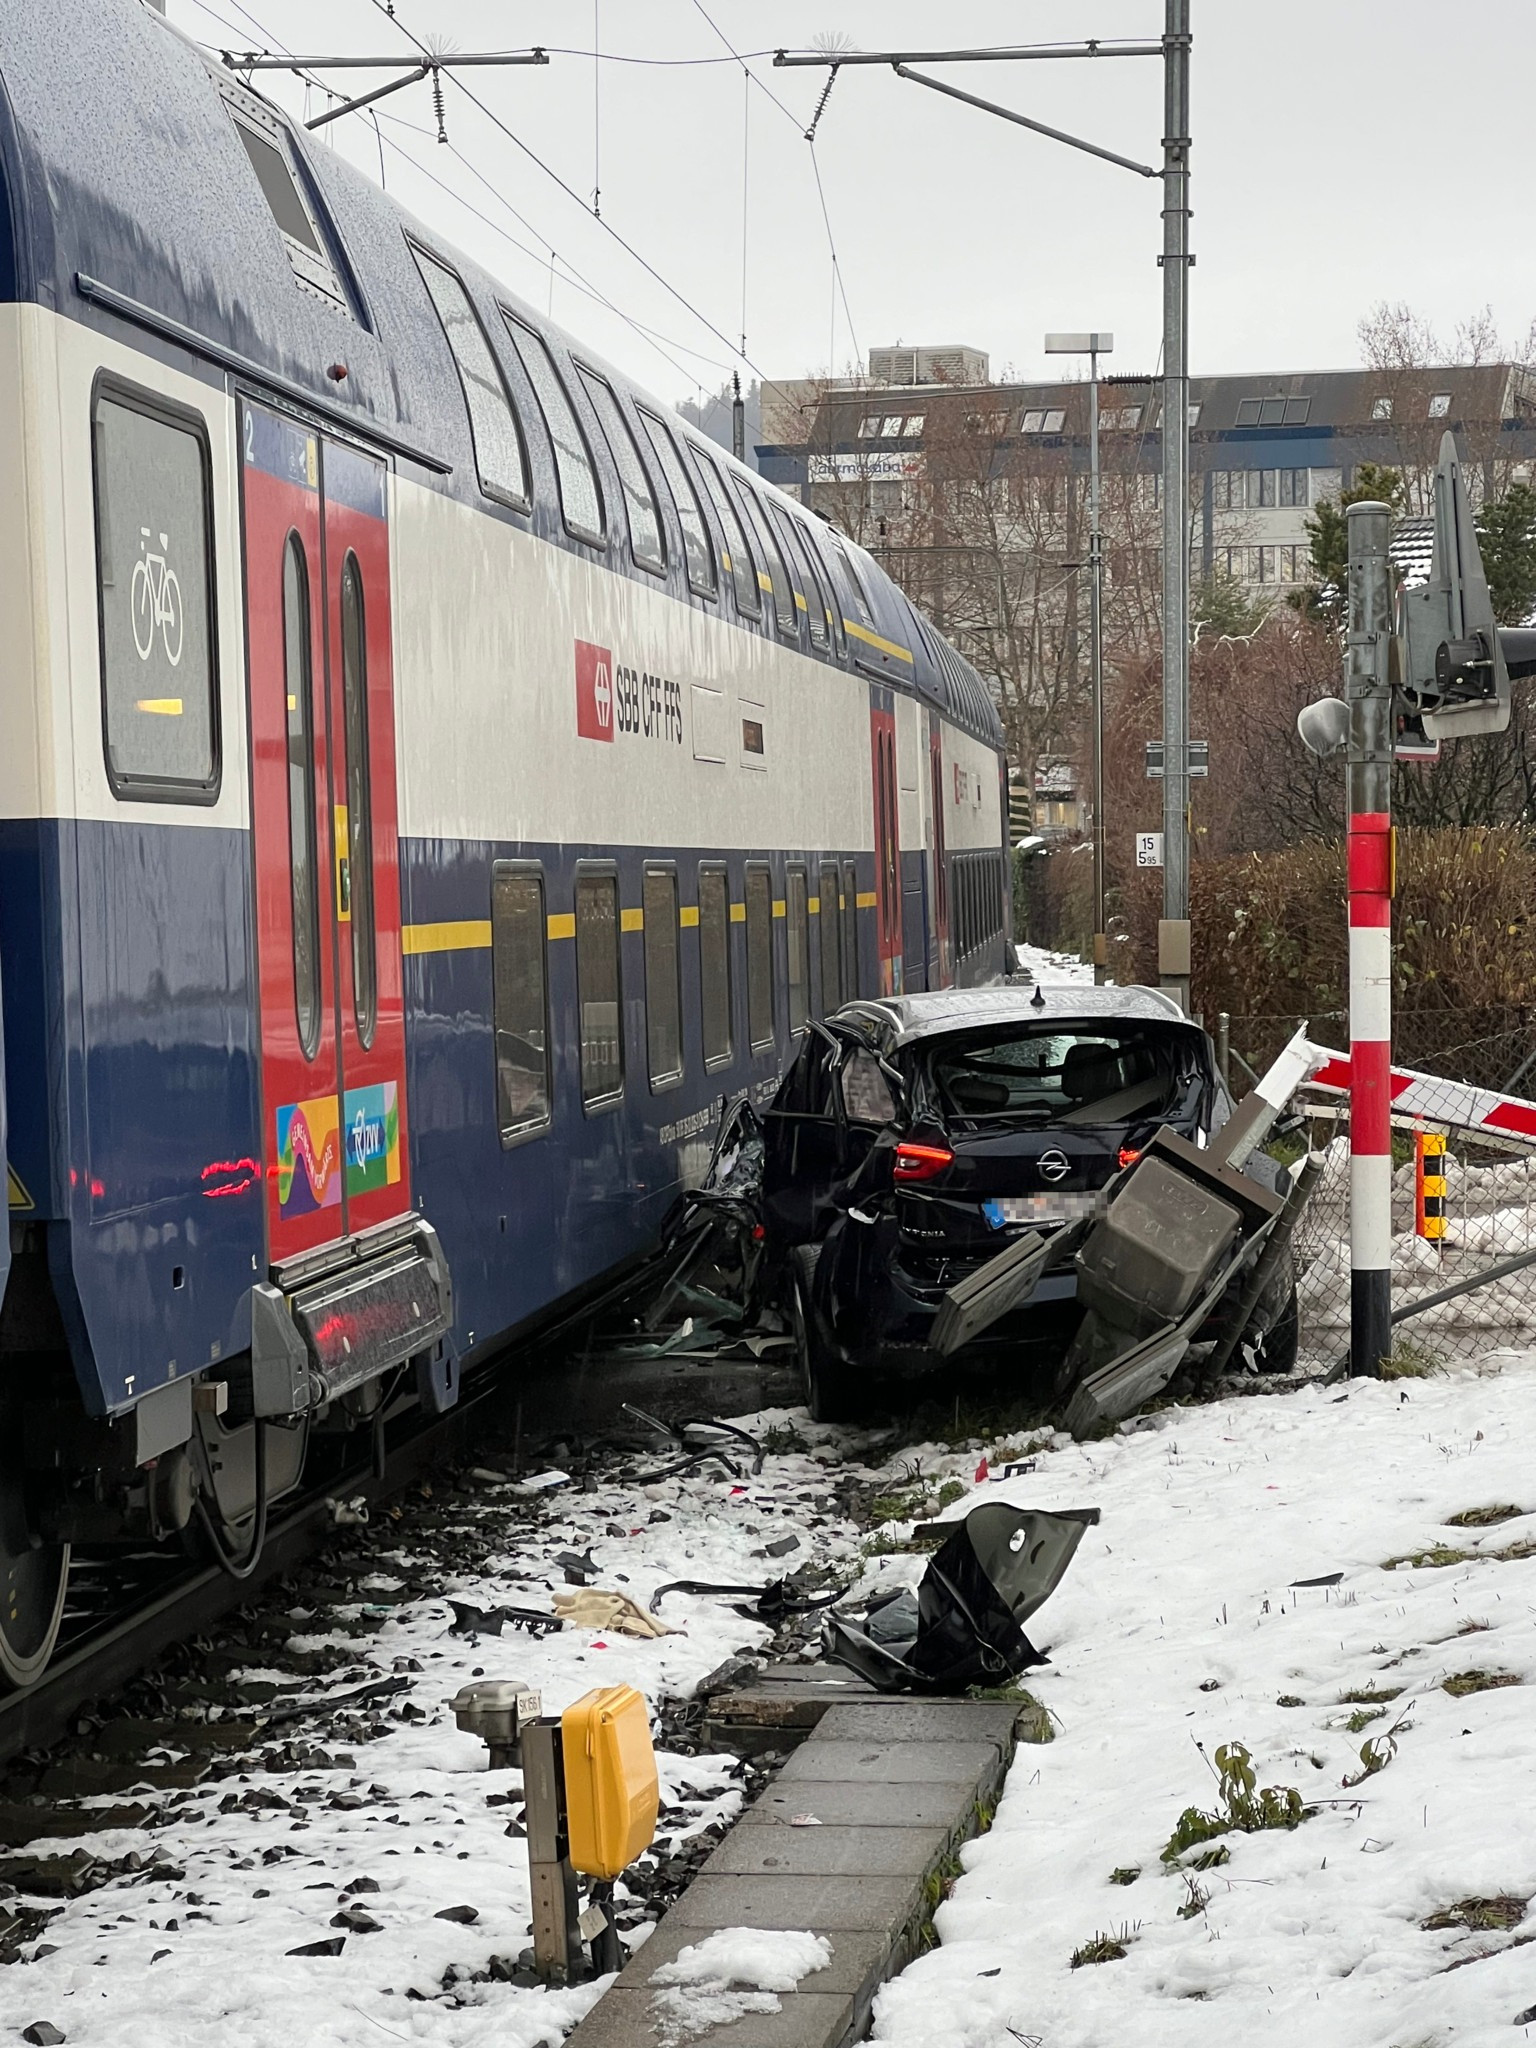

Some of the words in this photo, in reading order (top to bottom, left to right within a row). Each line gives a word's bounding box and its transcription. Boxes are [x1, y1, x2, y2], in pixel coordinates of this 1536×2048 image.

[245, 410, 254, 462] 2
[616, 664, 640, 734] SBB
[642, 672, 662, 739] CFF
[664, 679, 683, 745] FFS
[1142, 837, 1154, 850] 15
